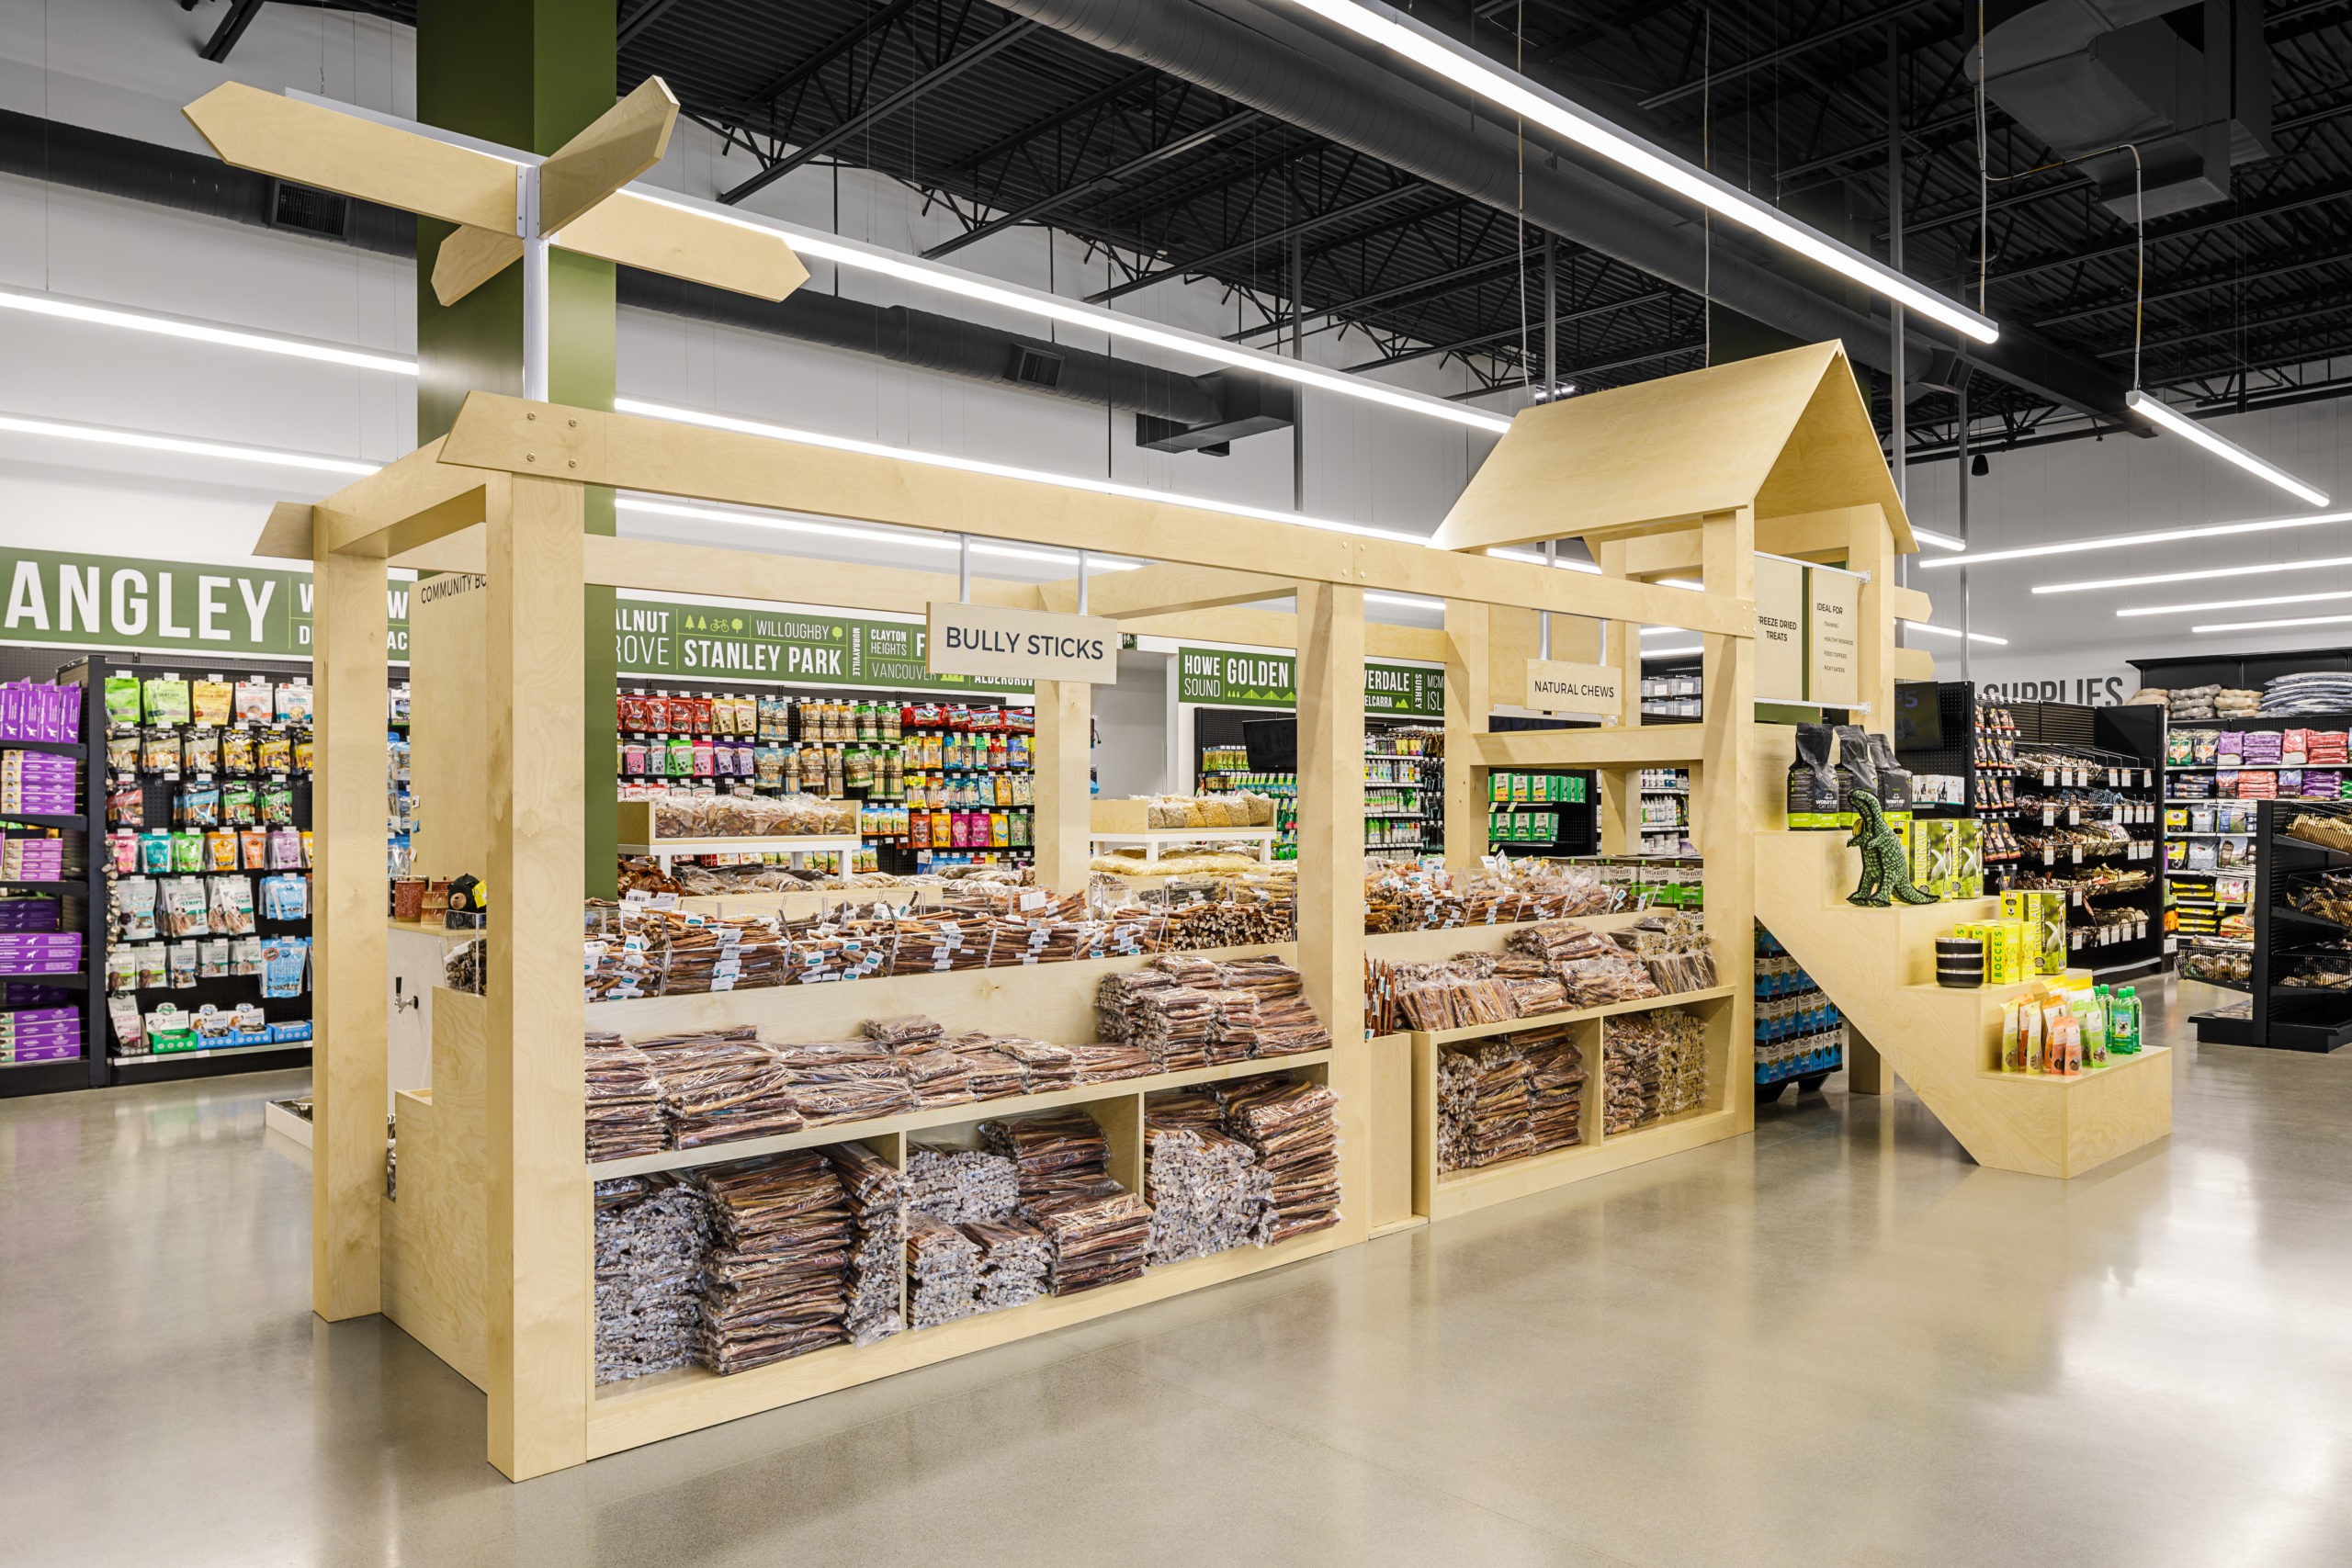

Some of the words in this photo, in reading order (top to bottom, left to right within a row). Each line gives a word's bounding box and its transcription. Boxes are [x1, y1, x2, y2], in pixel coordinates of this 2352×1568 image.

[421, 573, 472, 604] COMMUNITY
[5, 560, 276, 642] ANGLEY
[1816, 603, 1832, 613] IDEAL
[1832, 605, 1843, 615] FOR
[756, 620, 830, 640] WILLOUGHBY
[1780, 619, 1797, 630] DRIED
[871, 628, 907, 642] CLAYTON
[946, 626, 1021, 653] BULLY
[1027, 634, 1103, 660] STICKS
[1766, 630, 1788, 642] TREATS
[684, 639, 781, 671] STANLEY
[788, 646, 842, 675] PARK
[852, 627, 860, 677] MURRAYVILLE
[871, 641, 907, 656] HEIGHTS
[1184, 654, 1221, 676] HOWE
[1227, 658, 1289, 688] GOLDEN
[1184, 677, 1221, 697] SOUND
[1534, 681, 1578, 695] NATURAL
[1581, 684, 1614, 698] CHEWS
